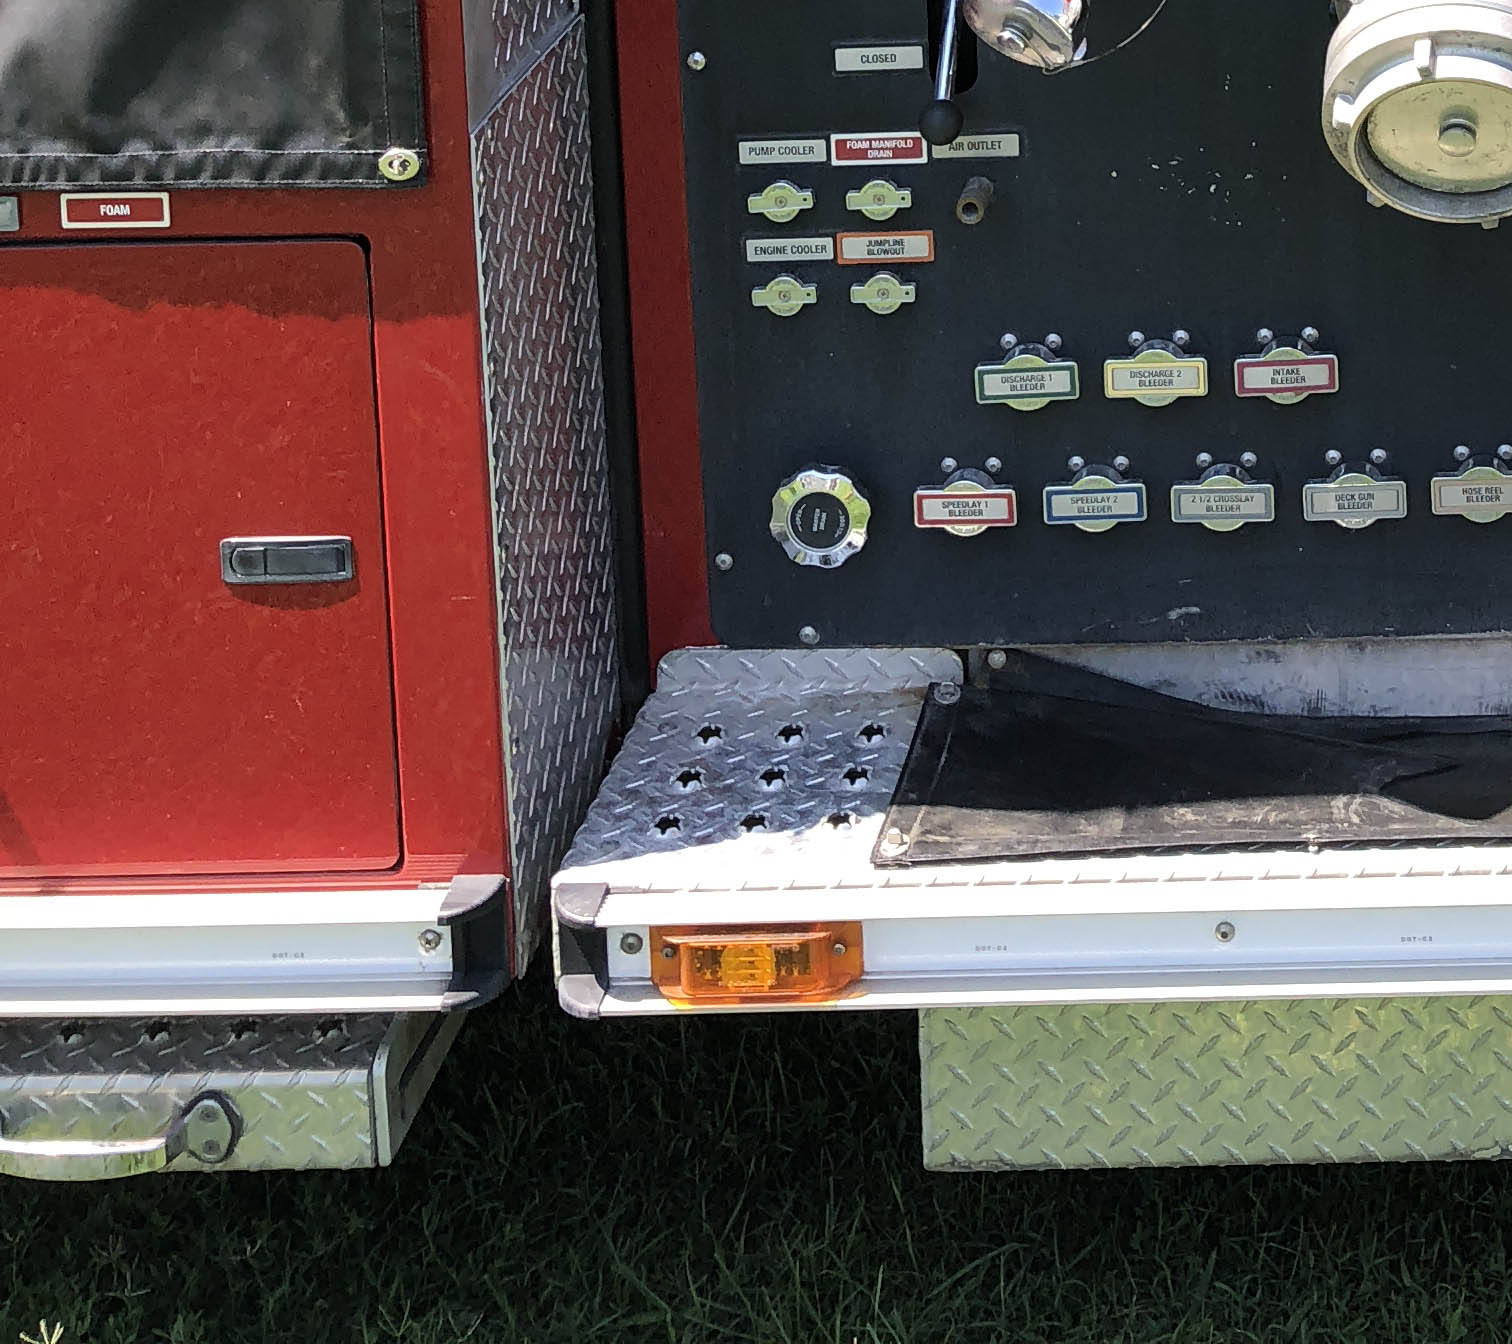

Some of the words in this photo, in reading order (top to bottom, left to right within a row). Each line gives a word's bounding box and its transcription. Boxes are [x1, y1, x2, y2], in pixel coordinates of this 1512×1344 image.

[860, 54, 896, 64] CLOSED
[846, 140, 870, 149] FOAM
[871, 139, 913, 149] MANIFOLD
[948, 142, 965, 151] AIR
[967, 141, 1002, 151] OUTLET
[748, 146, 775, 156] PUMP
[777, 145, 815, 155] COOLER
[867, 149, 893, 158] DRAIN
[100, 204, 130, 216] FOAM
[866, 238, 905, 247] JUMPLINE
[754, 245, 789, 255] ENGINE
[791, 244, 827, 255] COOLER
[866, 247, 905, 256] BLOWOUT
[1129, 370, 1173, 379] DISCHARGE
[1176, 370, 1182, 378] 2
[1272, 367, 1300, 376] INTAKE
[1001, 373, 1045, 384] DISCHARGE
[1048, 373, 1052, 382] 1
[1138, 378, 1174, 387] BLEEDER
[1270, 375, 1306, 384] BLEEDER
[1009, 381, 1046, 391] BLEEDER
[1462, 488, 1483, 496] HOSE
[1484, 487, 1504, 495] REEL
[1070, 496, 1111, 505] SPEEDLAY
[1112, 495, 1118, 504] 2
[1191, 495, 1197, 503] 2
[1199, 495, 1211, 503] 1/2
[1213, 495, 1254, 503] CROSSLAY
[1335, 494, 1356, 502] DECK
[1358, 493, 1374, 501] GUN
[1466, 495, 1501, 503] BLEEDER
[942, 500, 982, 509] SPEEDLAY
[984, 500, 988, 508] 1
[1077, 504, 1113, 513] BLEEDER
[1205, 504, 1241, 513] BLEEDER
[1337, 501, 1373, 510] BLEEDER
[948, 508, 983, 517] BLEEDER
